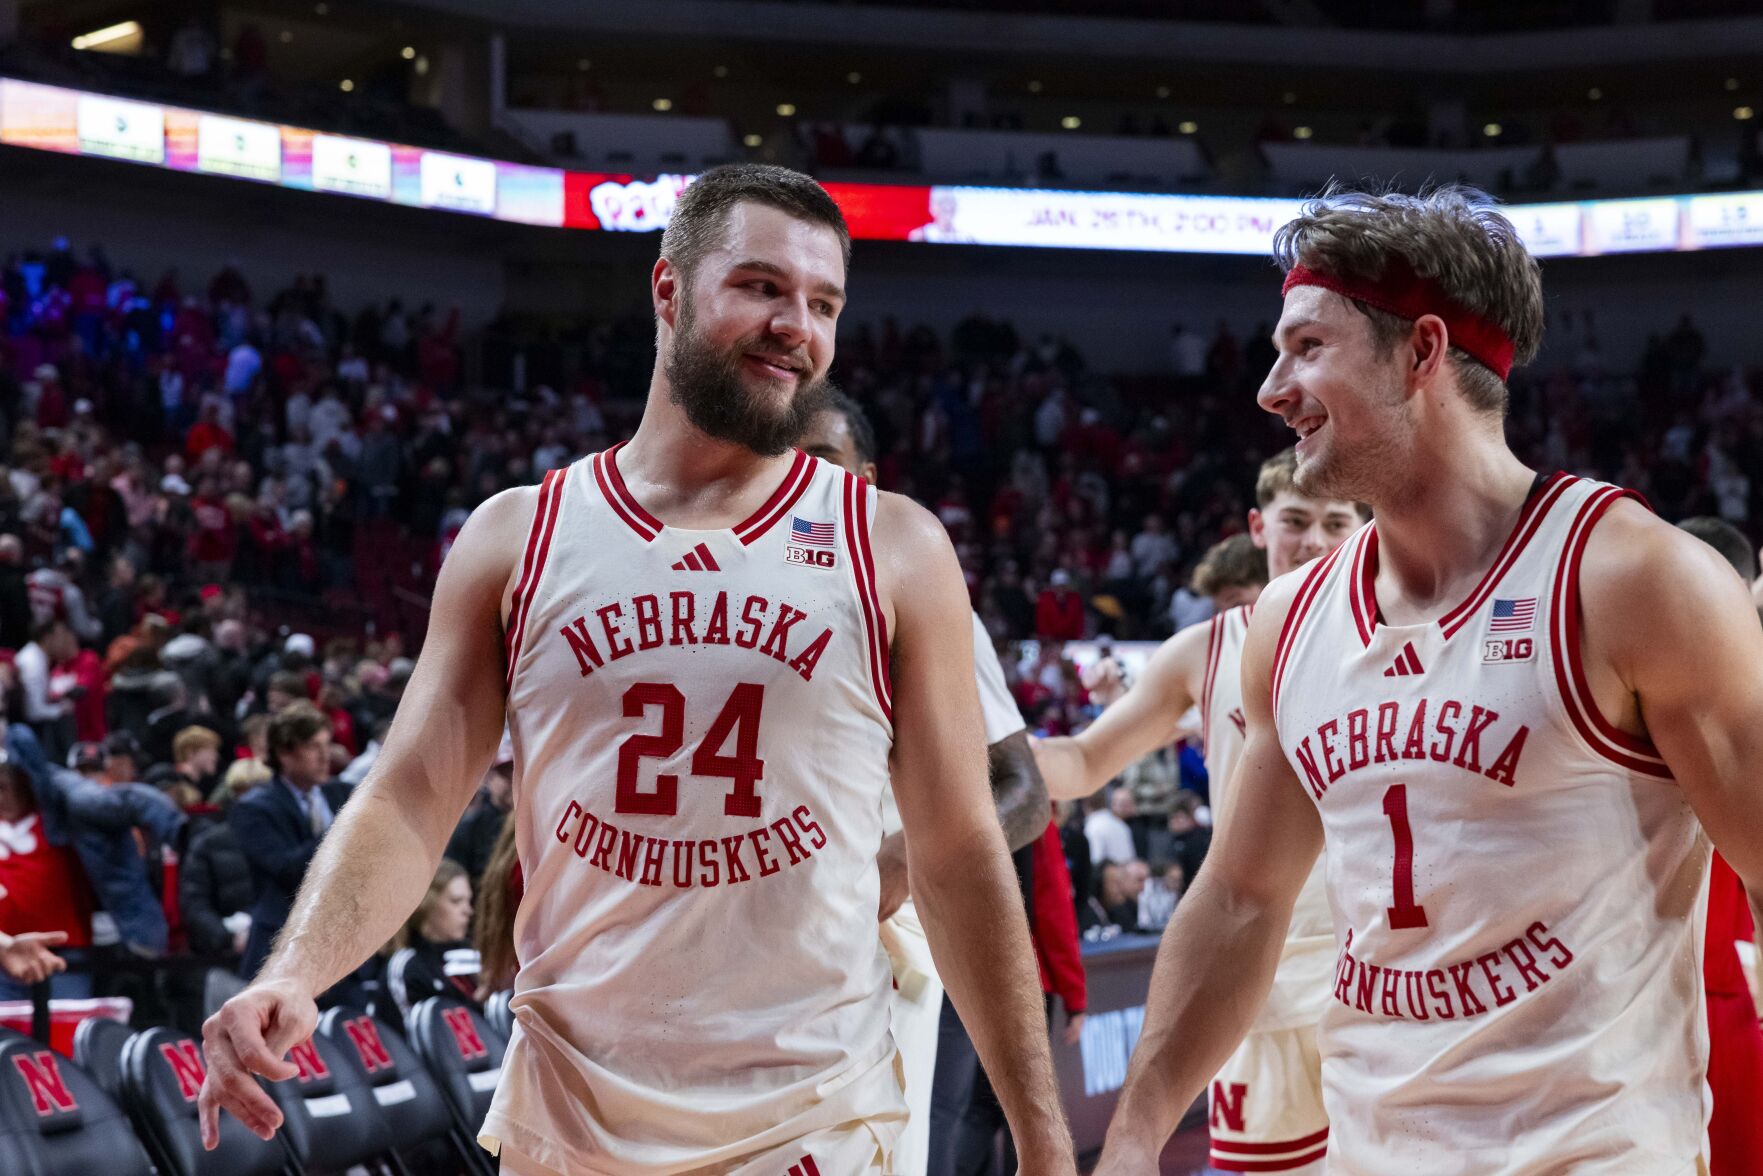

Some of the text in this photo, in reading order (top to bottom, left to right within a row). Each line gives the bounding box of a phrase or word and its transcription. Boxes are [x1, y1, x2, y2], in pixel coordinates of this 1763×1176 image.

[560, 591, 834, 681] NEBRASKA
[614, 682, 765, 818] 24
[1295, 698, 1529, 801] NEBRASKA
[555, 799, 827, 888] CORNHUSKERS
[1382, 783, 1429, 930] 1
[1334, 920, 1574, 1021] RNHUSKERS
[342, 1015, 395, 1074] N
[440, 1006, 489, 1061] N
[11, 1050, 78, 1117] N
[1210, 1079, 1249, 1133] N
